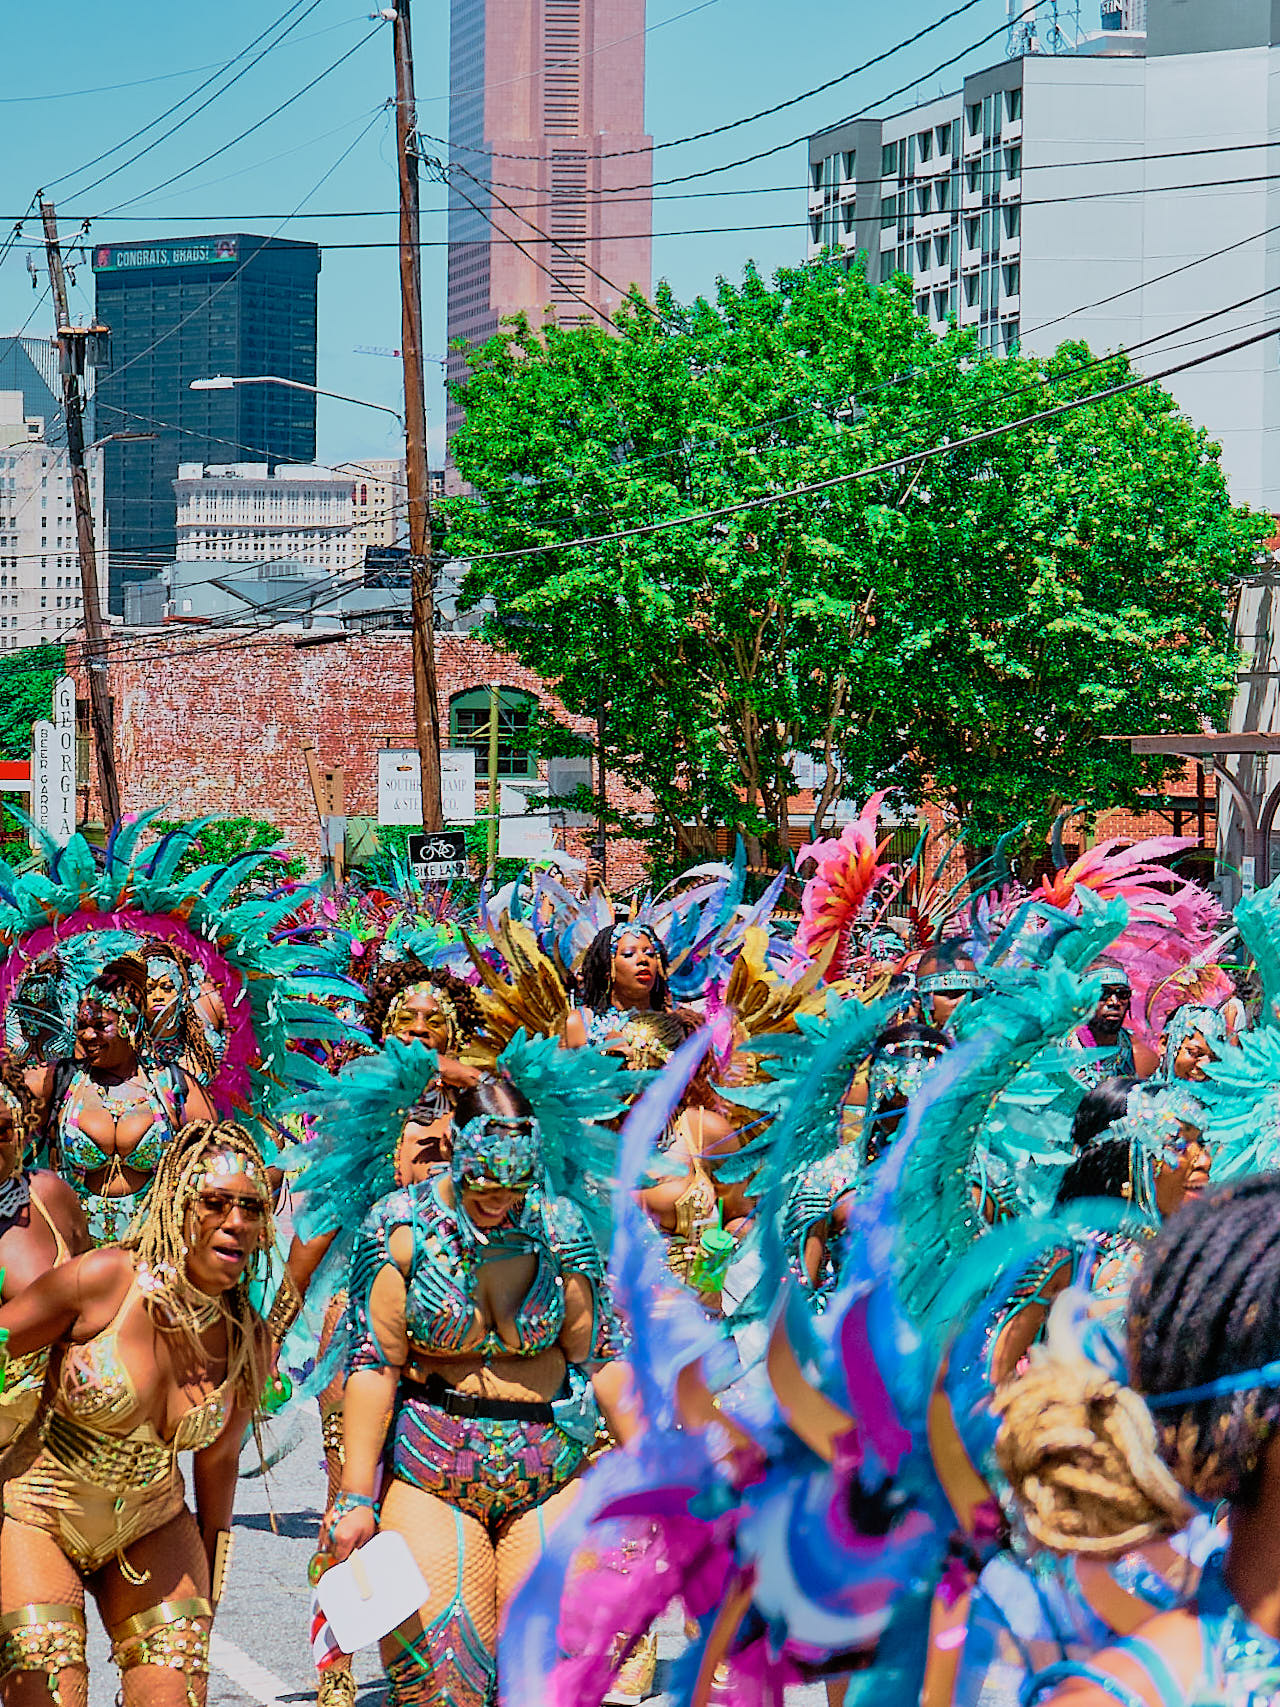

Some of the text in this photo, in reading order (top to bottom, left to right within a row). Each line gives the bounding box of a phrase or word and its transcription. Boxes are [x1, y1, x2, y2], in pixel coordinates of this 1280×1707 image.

[116, 245, 209, 267] CONGRATS, GRADS!
[40, 729, 48, 769] BEER
[60, 690, 72, 834] GEORGIA
[385, 779, 467, 792] SOUTHE TAMP
[402, 798, 419, 811] STE
[413, 862, 464, 878] BIKE LA
